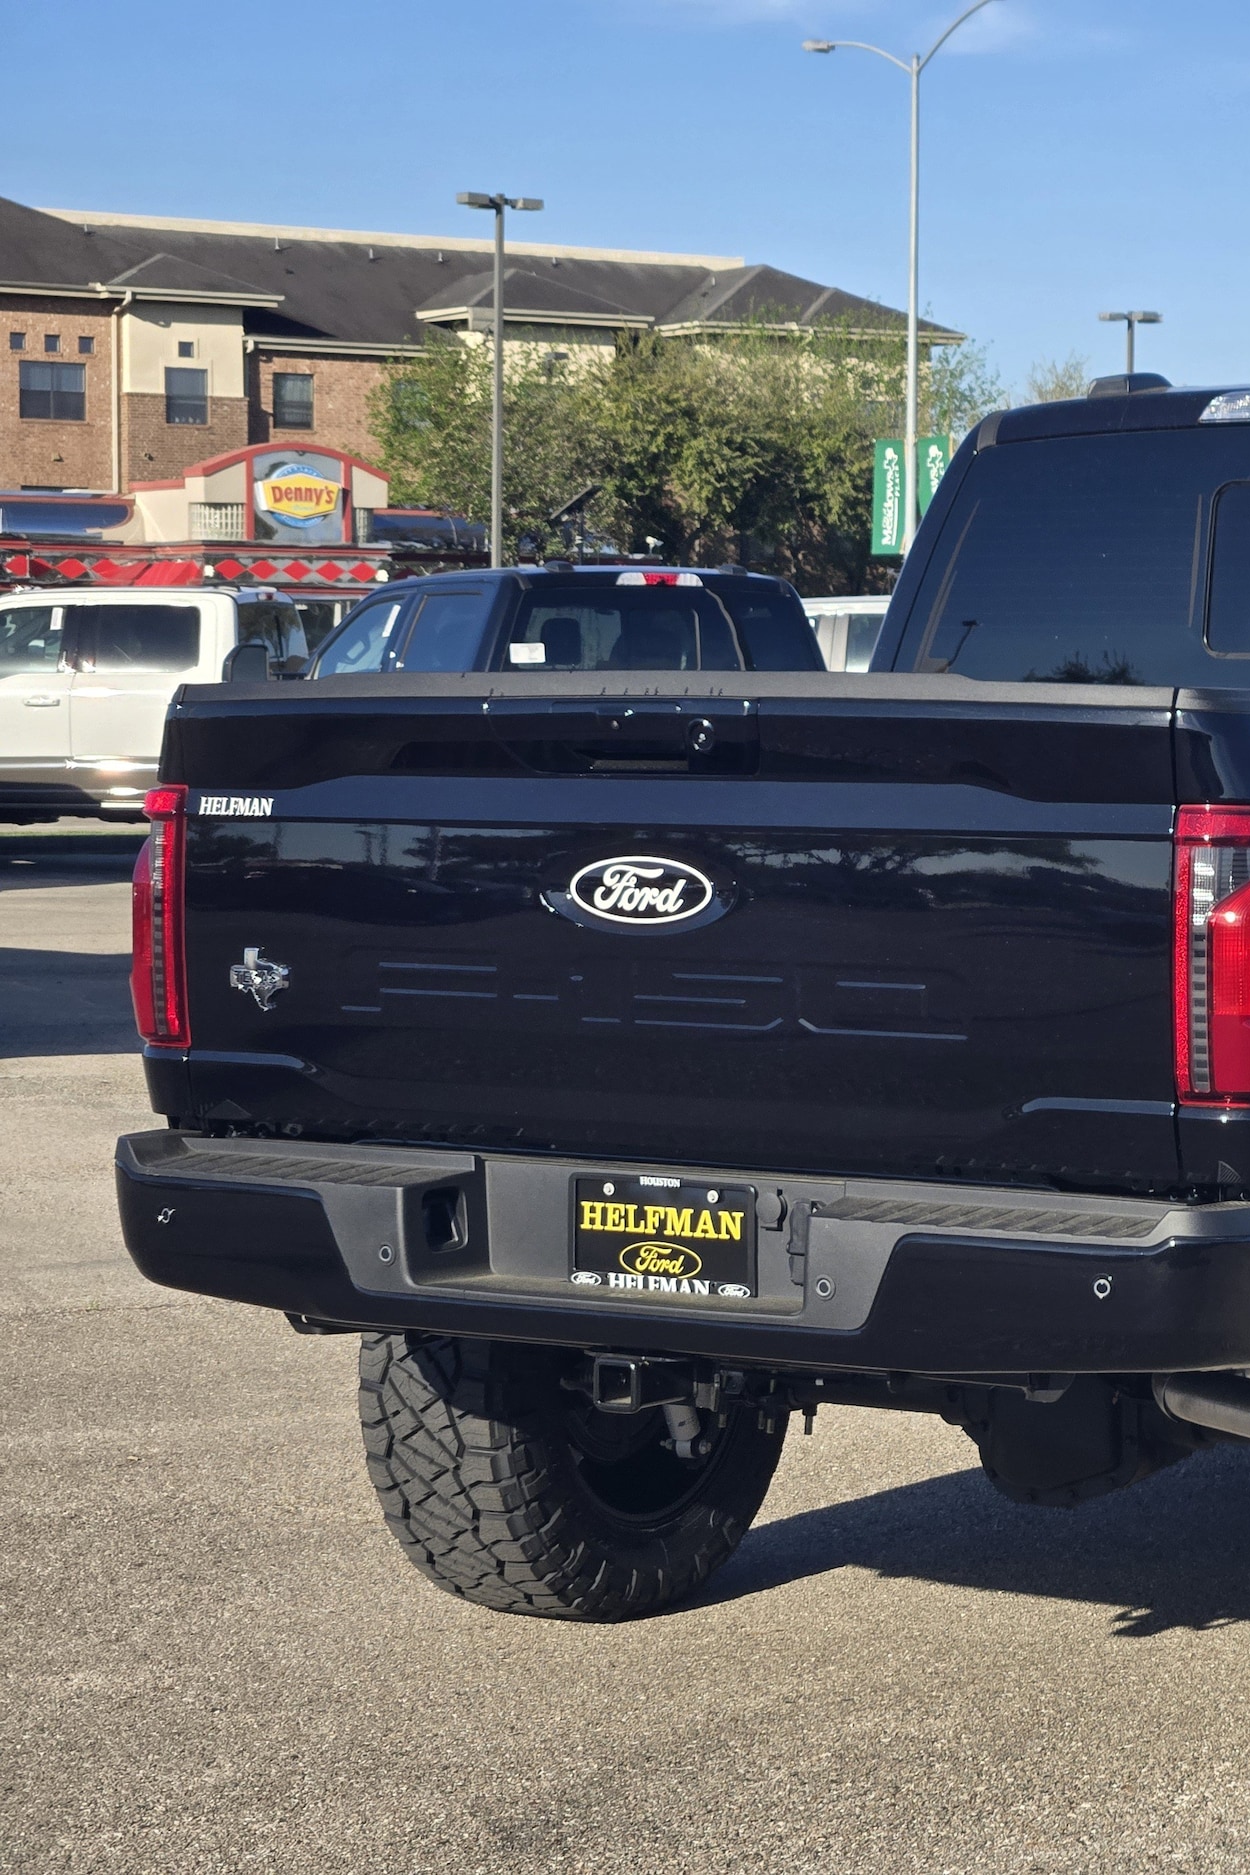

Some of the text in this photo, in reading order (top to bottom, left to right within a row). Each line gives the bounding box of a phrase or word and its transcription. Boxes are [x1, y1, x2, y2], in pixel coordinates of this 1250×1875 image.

[271, 485, 335, 506] Denny's
[198, 796, 275, 817] HELFMAN
[593, 864, 687, 913] Ford
[639, 1175, 681, 1188] HOUSTON
[580, 1200, 745, 1241] HELFMAN
[634, 1245, 686, 1275] Ford
[607, 1272, 711, 1296] HELFMAN
